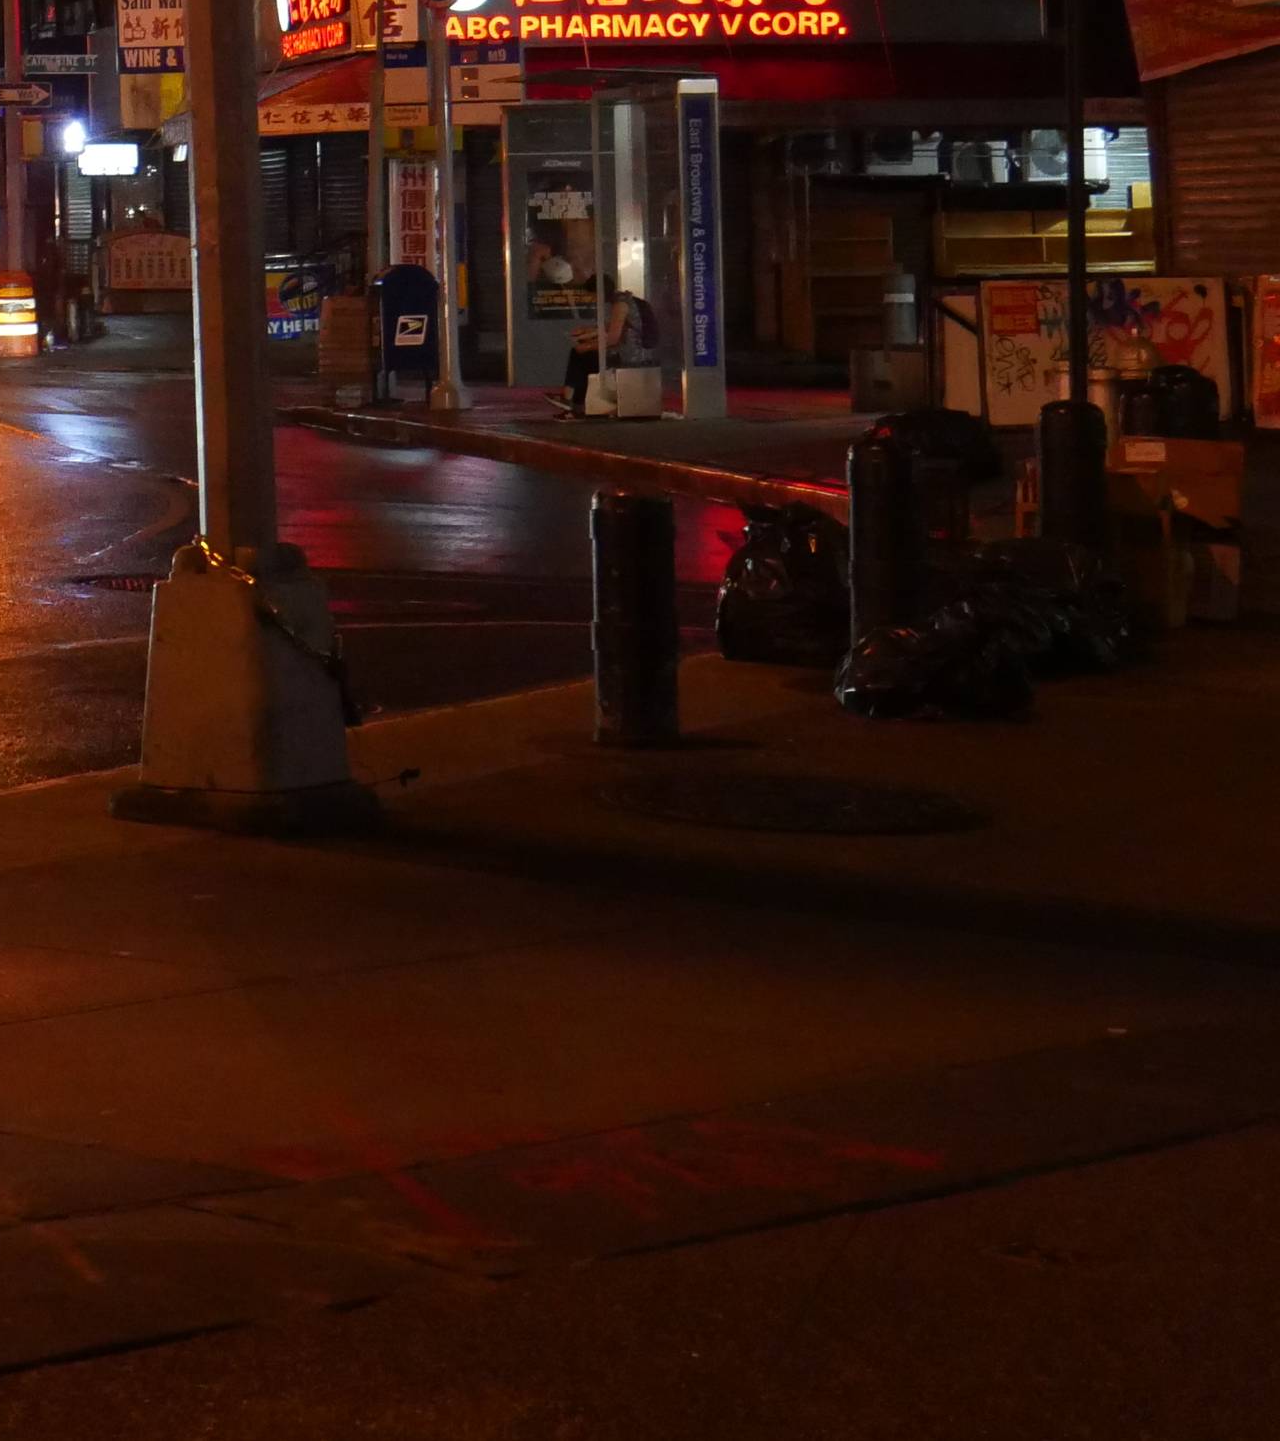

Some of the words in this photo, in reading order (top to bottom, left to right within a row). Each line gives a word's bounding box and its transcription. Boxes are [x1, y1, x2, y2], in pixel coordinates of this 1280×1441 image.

[446, 15, 512, 40] ABC
[520, 13, 709, 39] PHARMACY
[720, 13, 742, 36] V
[748, 12, 847, 36] CORP.
[123, 48, 161, 69] WINE
[166, 48, 177, 67] &
[18, 90, 39, 100] WAY
[688, 117, 704, 149] East
[688, 152, 705, 224] Broadway
[692, 227, 705, 238] &
[692, 241, 708, 310] Catherine
[694, 314, 709, 356] Street
